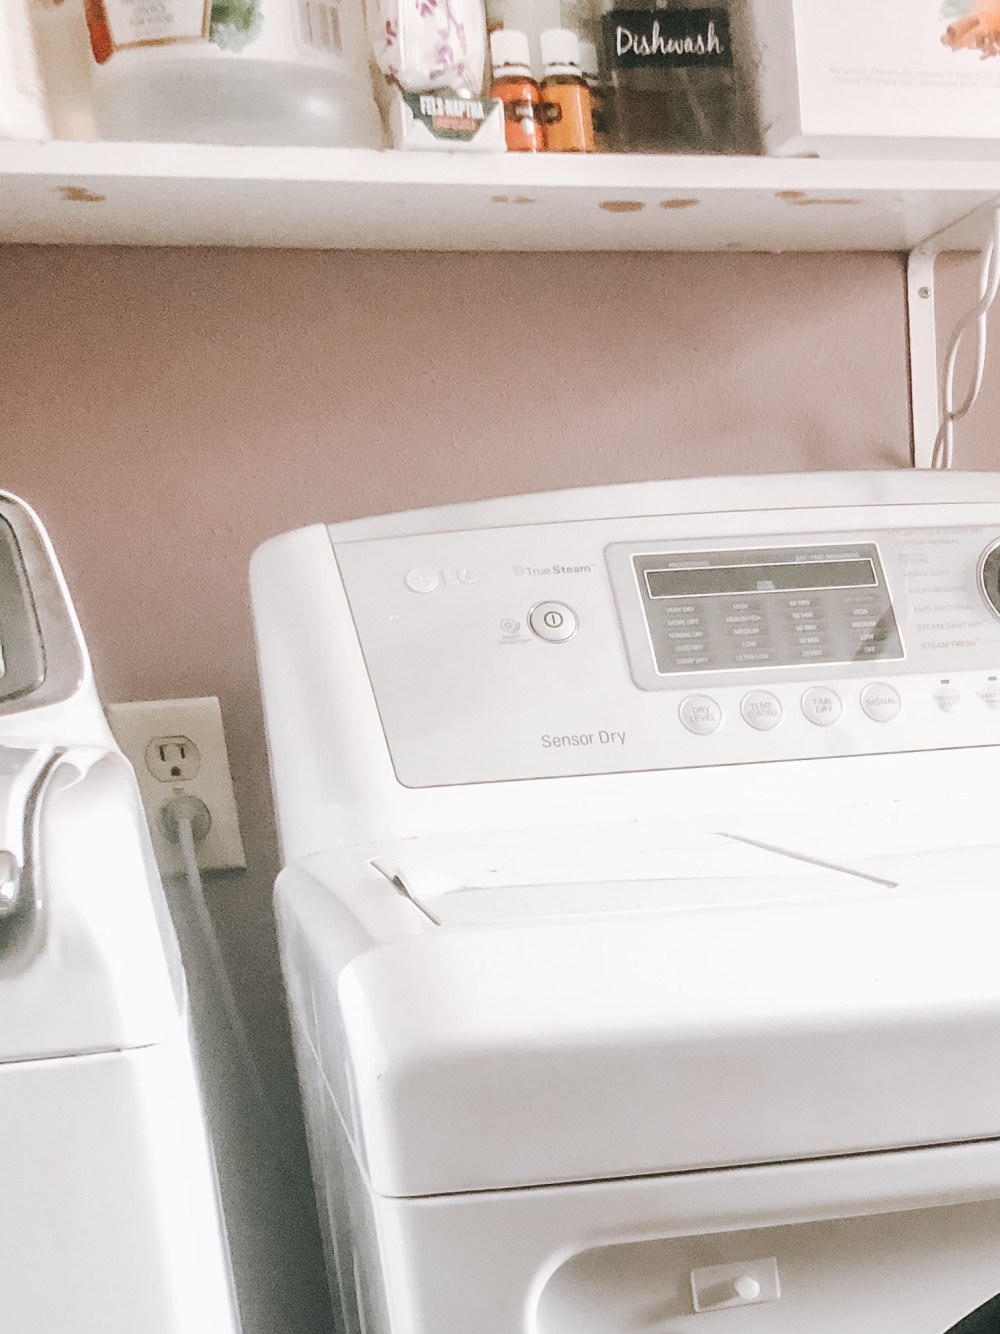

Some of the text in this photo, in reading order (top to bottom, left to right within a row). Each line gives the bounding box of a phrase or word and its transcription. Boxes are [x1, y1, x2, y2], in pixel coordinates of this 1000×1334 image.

[616, 19, 721, 56] Dishwash
[441, 567, 480, 587] LG
[525, 566, 551, 577] True
[917, 624, 944, 632] STEAM
[921, 640, 977, 650] STEAM FRESH
[813, 696, 832, 706] TIME
[865, 696, 897, 707] SIGNAL
[691, 705, 710, 716] DRY
[747, 709, 779, 720] CONTROL
[815, 704, 832, 714] DRY
[689, 712, 714, 723] LEVEL
[541, 730, 627, 749] Sensor Dry
